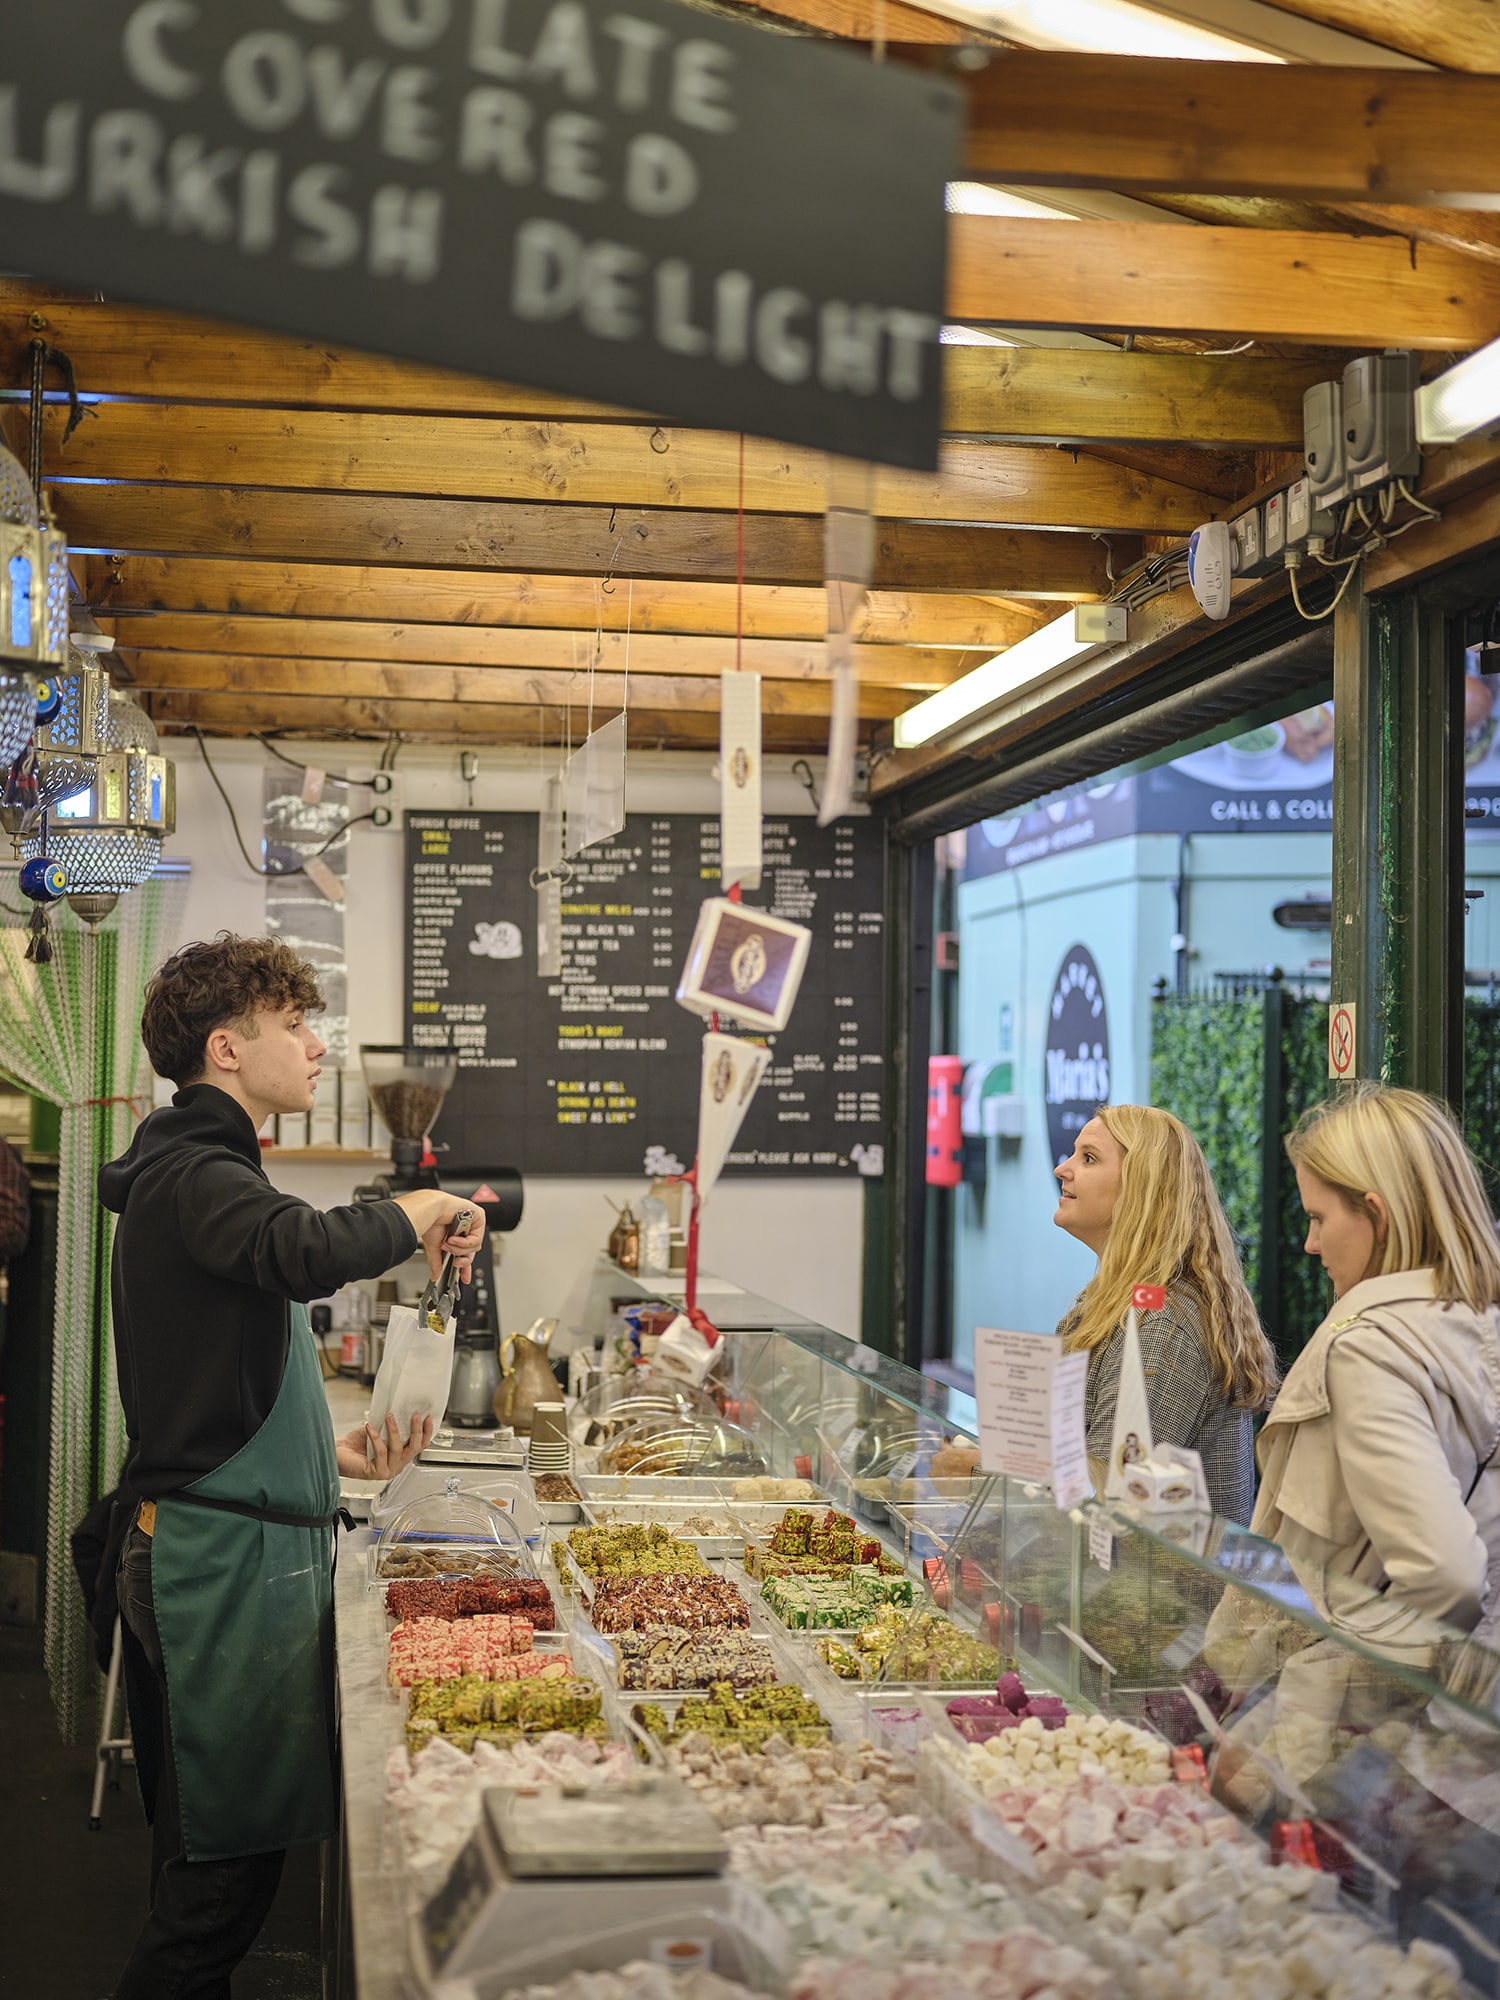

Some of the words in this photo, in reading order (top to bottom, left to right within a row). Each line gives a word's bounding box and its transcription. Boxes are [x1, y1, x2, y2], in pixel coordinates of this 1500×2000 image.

[123, 0, 698, 215] COVERED
[510, 217, 941, 400] DELIGHT
[1211, 801, 1262, 820] CALL
[1266, 800, 1281, 820] &
[410, 818, 445, 829] TURKISH
[447, 818, 480, 830] COFFEE
[422, 831, 451, 842] SMALL
[422, 843, 449, 854] LARGE
[605, 848, 632, 860] LATTE
[414, 864, 446, 875] COFFEE
[449, 864, 493, 876] FLAVOURS
[592, 863, 624, 875] COFFEE
[414, 907, 455, 916] CINNAMON
[605, 904, 632, 915] MILKS
[414, 927, 441, 936] CLOVE
[586, 924, 614, 935] BLACK
[618, 924, 635, 935] TEA
[576, 939, 599, 951] MINT
[603, 939, 620, 951] TEA
[414, 958, 441, 967] COCOA
[575, 954, 597, 966] TEAS
[414, 979, 448, 987] VANILLA
[548, 985, 565, 996] HOT
[568, 985, 609, 996] OTTOMAN
[612, 985, 642, 997] SPICED
[644, 985, 669, 997] DRINK
[413, 1001, 440, 1013] DECAF
[413, 1025, 451, 1035] FRESHLY
[454, 1025, 487, 1035] GROUND
[559, 1025, 593, 1037] TODAY'S
[596, 1026, 624, 1036] ROAST
[413, 1035, 449, 1046] TURKISH
[454, 1036, 486, 1047] COFFEE
[558, 1039, 601, 1050] ETHIOPIAN
[604, 1039, 637, 1050] KENYAN
[639, 1039, 667, 1050] BLEND
[588, 1082, 601, 1093] AS
[603, 1082, 625, 1093] HELL
[557, 1097, 591, 1108] STRONG
[593, 1097, 606, 1108] AS
[608, 1097, 636, 1108] DEATH
[557, 1112, 587, 1123] SWEET
[590, 1112, 603, 1123] AS
[757, 1152, 790, 1163] PLEASE
[792, 1152, 810, 1163] ASK
